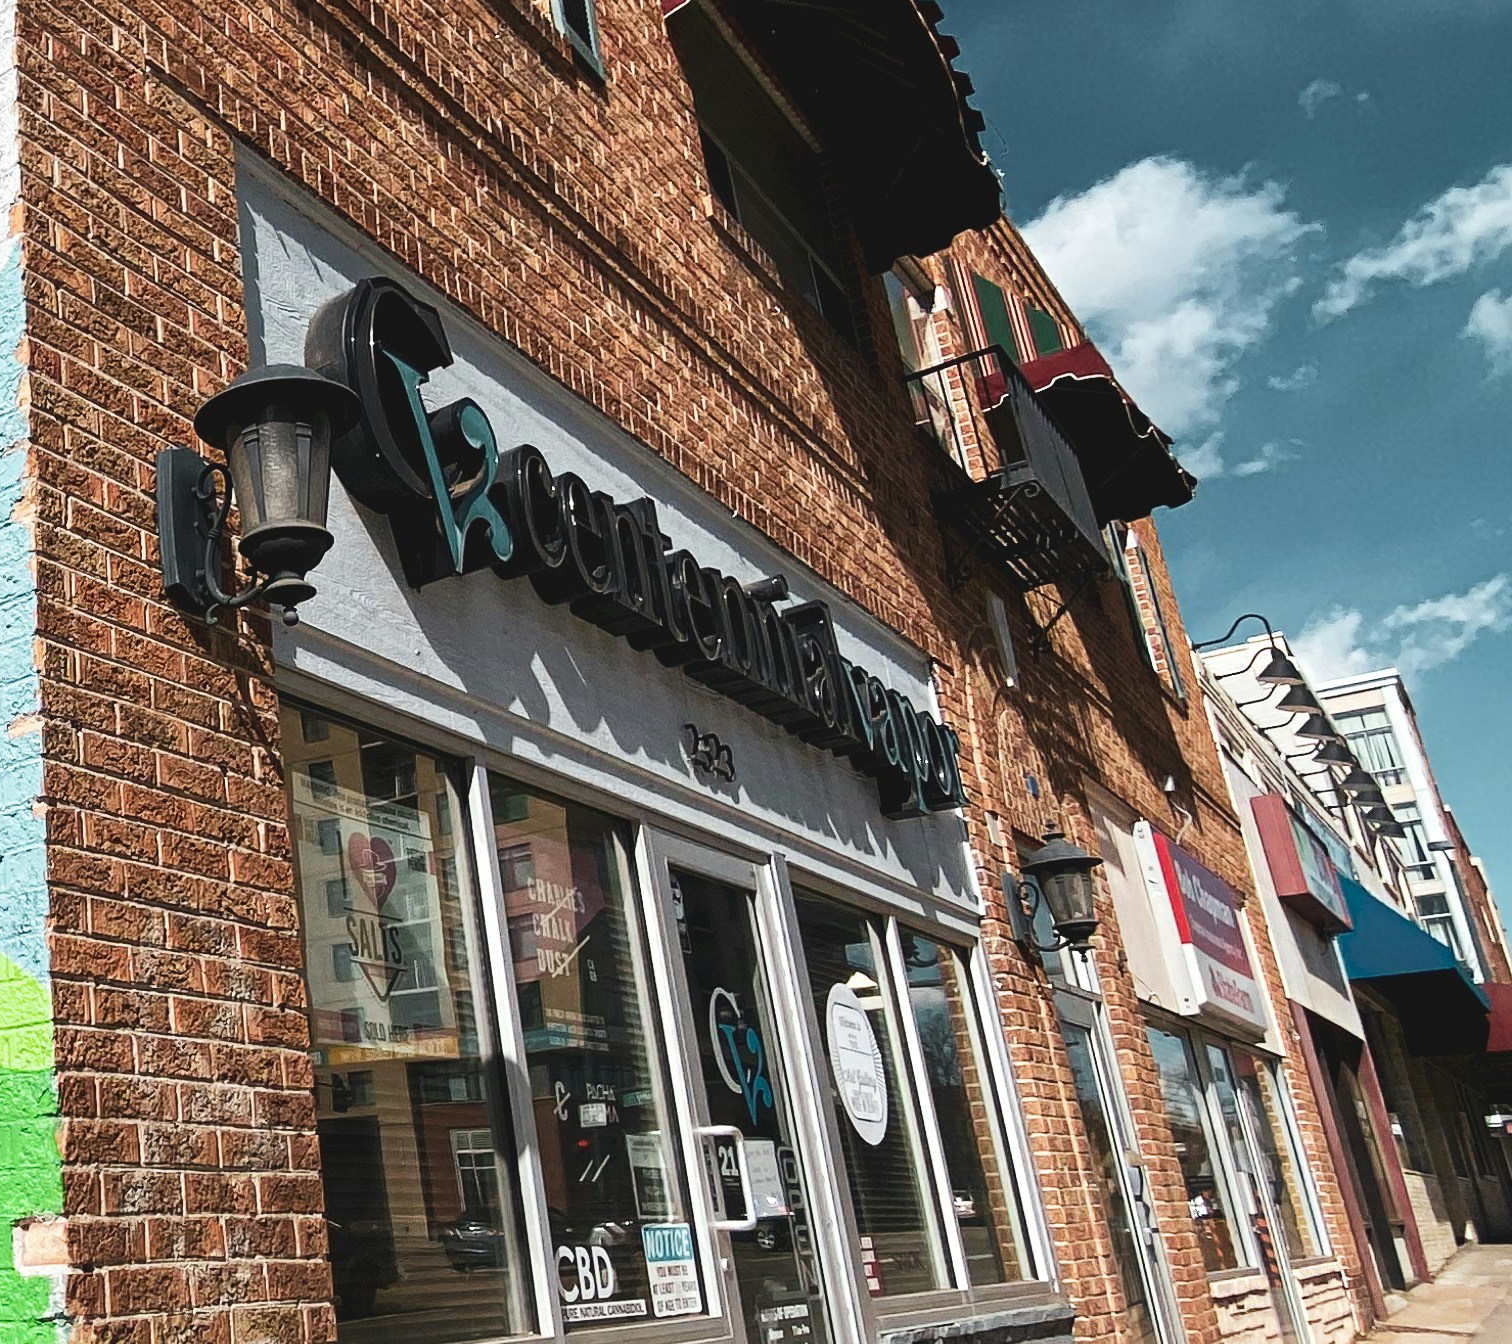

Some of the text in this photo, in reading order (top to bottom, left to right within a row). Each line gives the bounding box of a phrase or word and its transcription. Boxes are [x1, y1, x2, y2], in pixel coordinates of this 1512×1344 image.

[346, 914, 402, 965] SALTS
[532, 912, 575, 943] CHALK
[536, 948, 571, 977] DUST
[645, 1230, 691, 1259] NOTICE
[555, 1245, 615, 1303] CBD
[659, 1281, 675, 1294] LEAST
